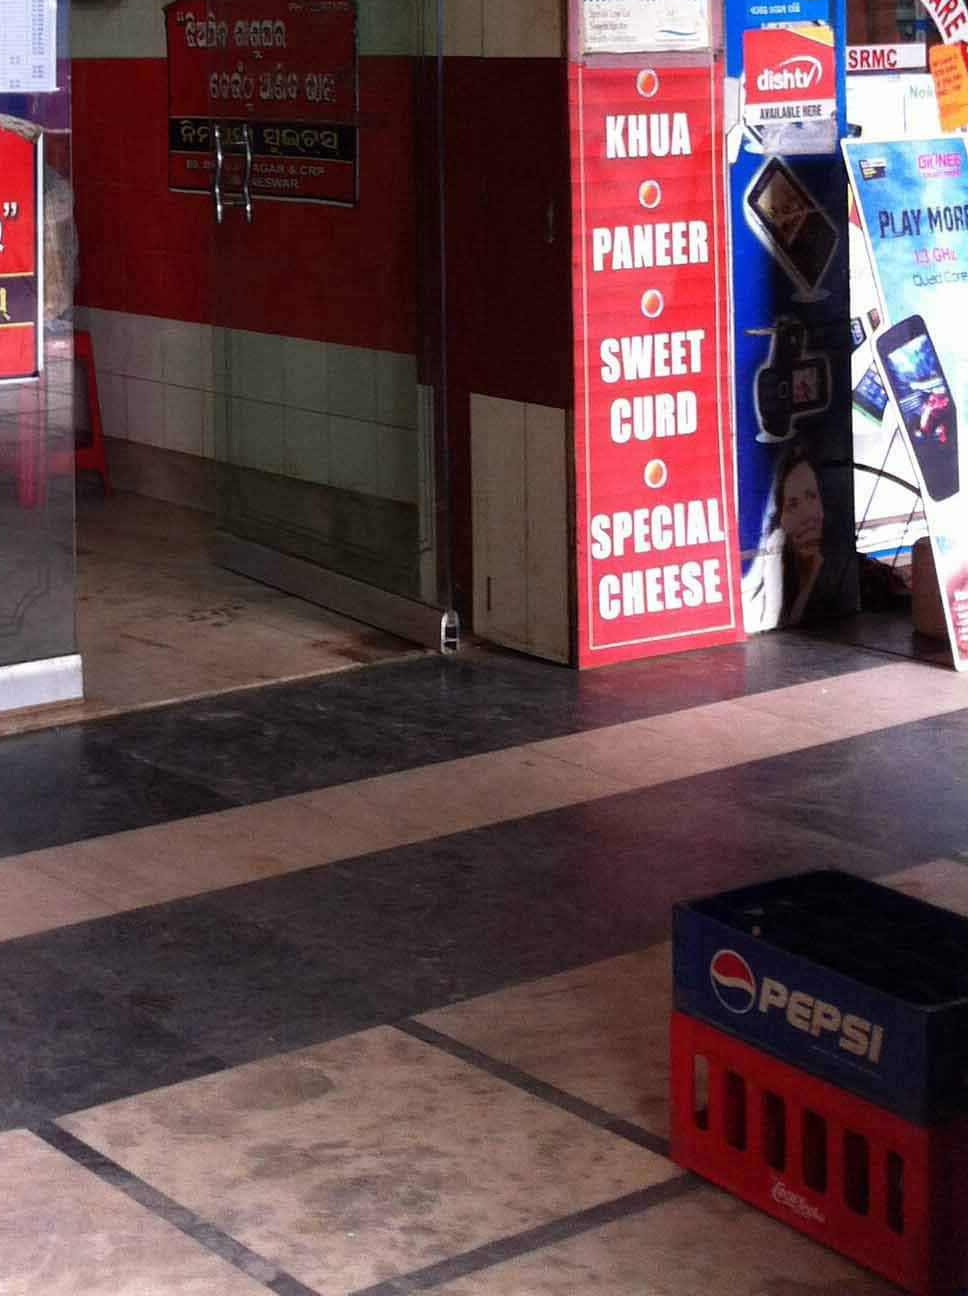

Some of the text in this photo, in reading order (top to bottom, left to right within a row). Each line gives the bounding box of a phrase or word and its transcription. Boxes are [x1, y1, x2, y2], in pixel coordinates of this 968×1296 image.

[605, 111, 693, 159] KHUA
[760, 104, 822, 120] AVAILABLE HERE
[592, 221, 709, 272] PANEER
[878, 207, 921, 239] PLAY
[600, 328, 705, 383] SWEET
[610, 390, 698, 445] CURD
[591, 497, 726, 560] SPECIAL
[598, 558, 723, 621] CHEESE
[758, 976, 885, 1065] PEPSI
